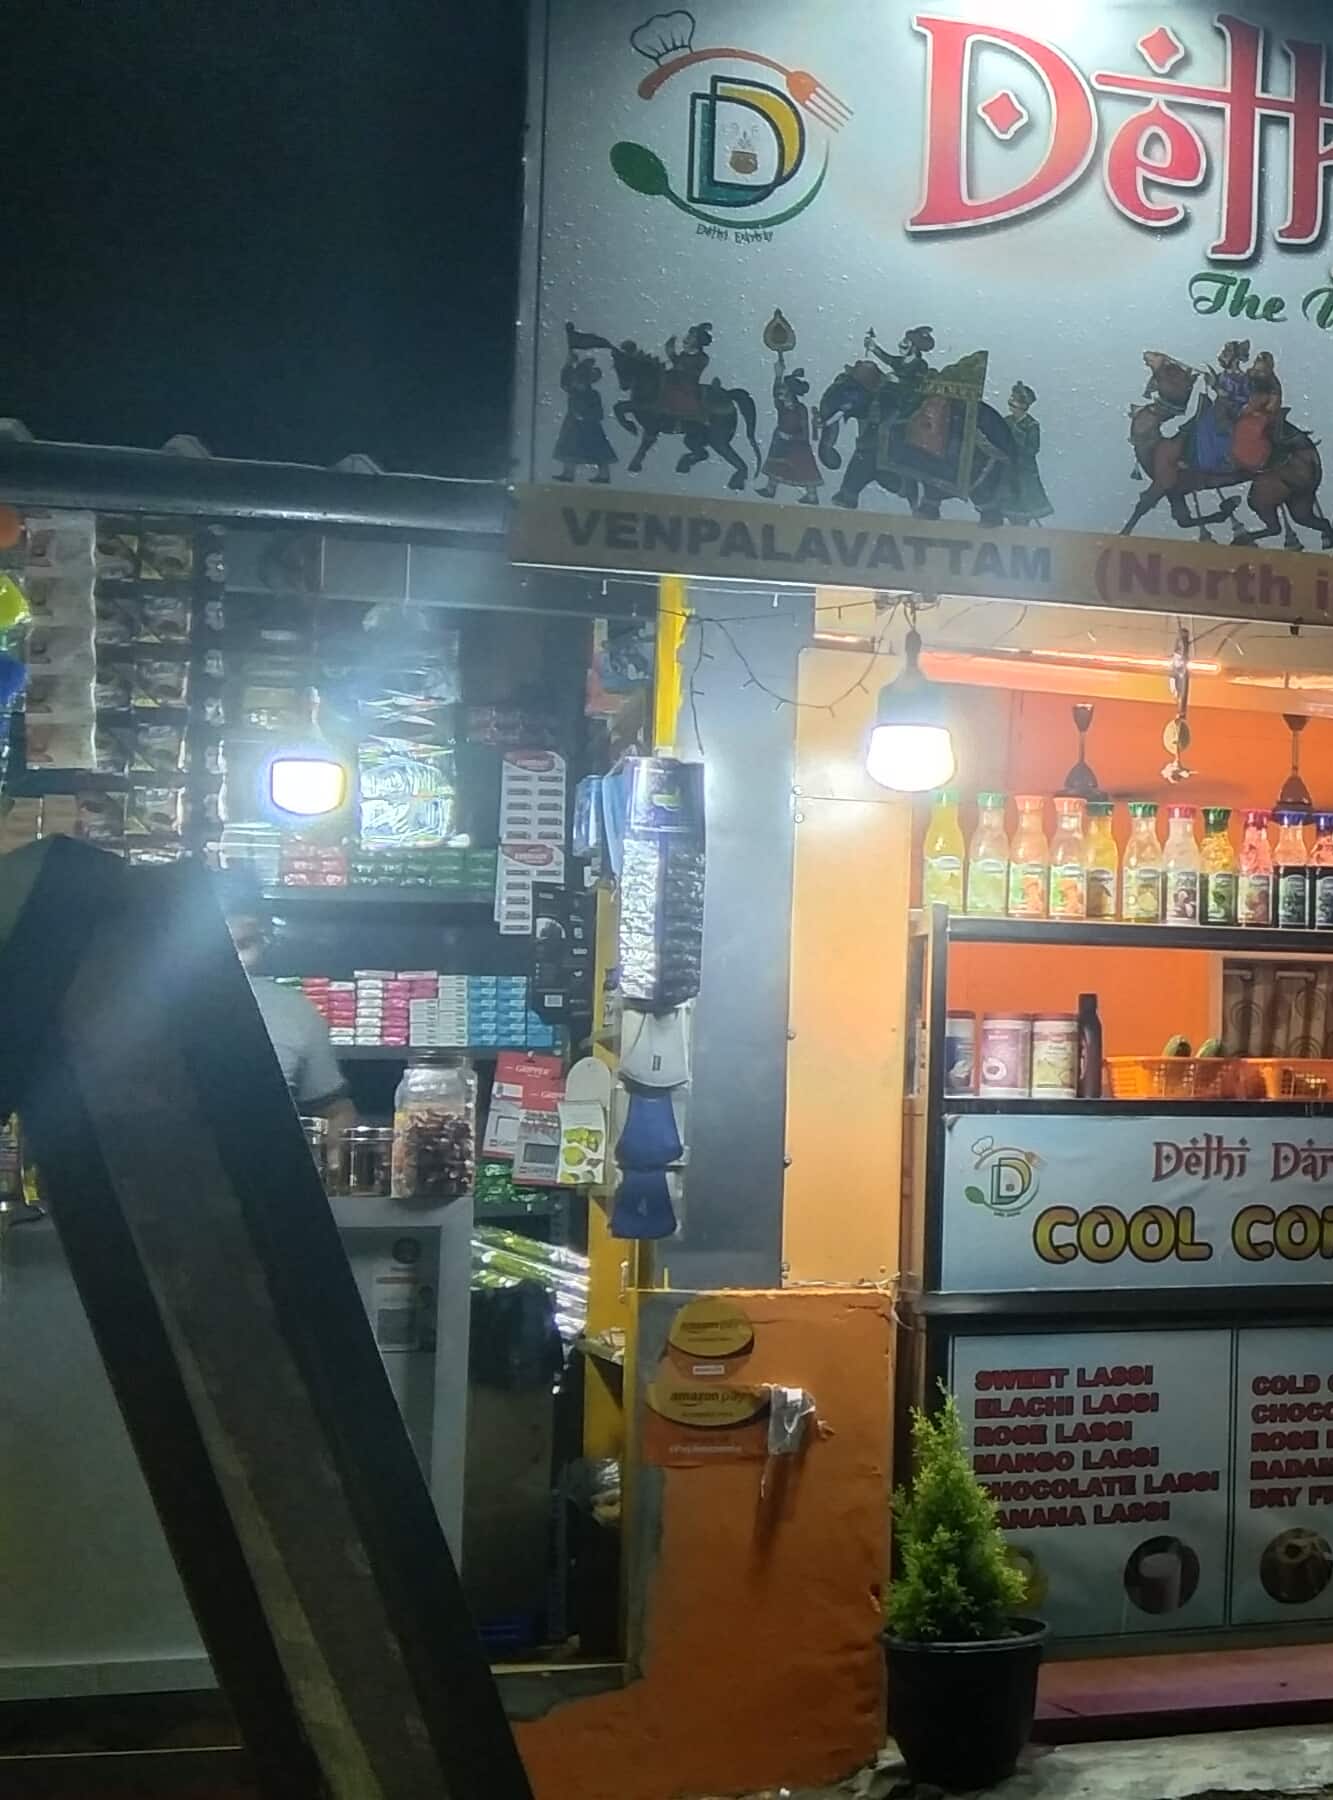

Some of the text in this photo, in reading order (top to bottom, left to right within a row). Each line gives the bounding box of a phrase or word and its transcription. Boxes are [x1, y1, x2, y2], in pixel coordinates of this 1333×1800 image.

[1189, 272, 1286, 324] The
[561, 506, 1053, 583] VENPALAVATTAM
[1094, 544, 1293, 609] (North
[1152, 1132, 1251, 1182] Delhi
[1033, 1205, 1213, 1263] COOL
[974, 1365, 1154, 1391] SWEET LASSI
[1252, 1374, 1321, 1395] COLD
[974, 1393, 1160, 1419] ELACHI LASSI
[974, 1420, 1133, 1447] ROSE LASSI
[1251, 1430, 1318, 1452] ROSE
[973, 1446, 1160, 1475] MANGO LASSI
[1144, 1470, 1220, 1492] LASSI
[1250, 1487, 1302, 1509] DRY
[996, 1500, 1171, 1530] ANANA LASSI
